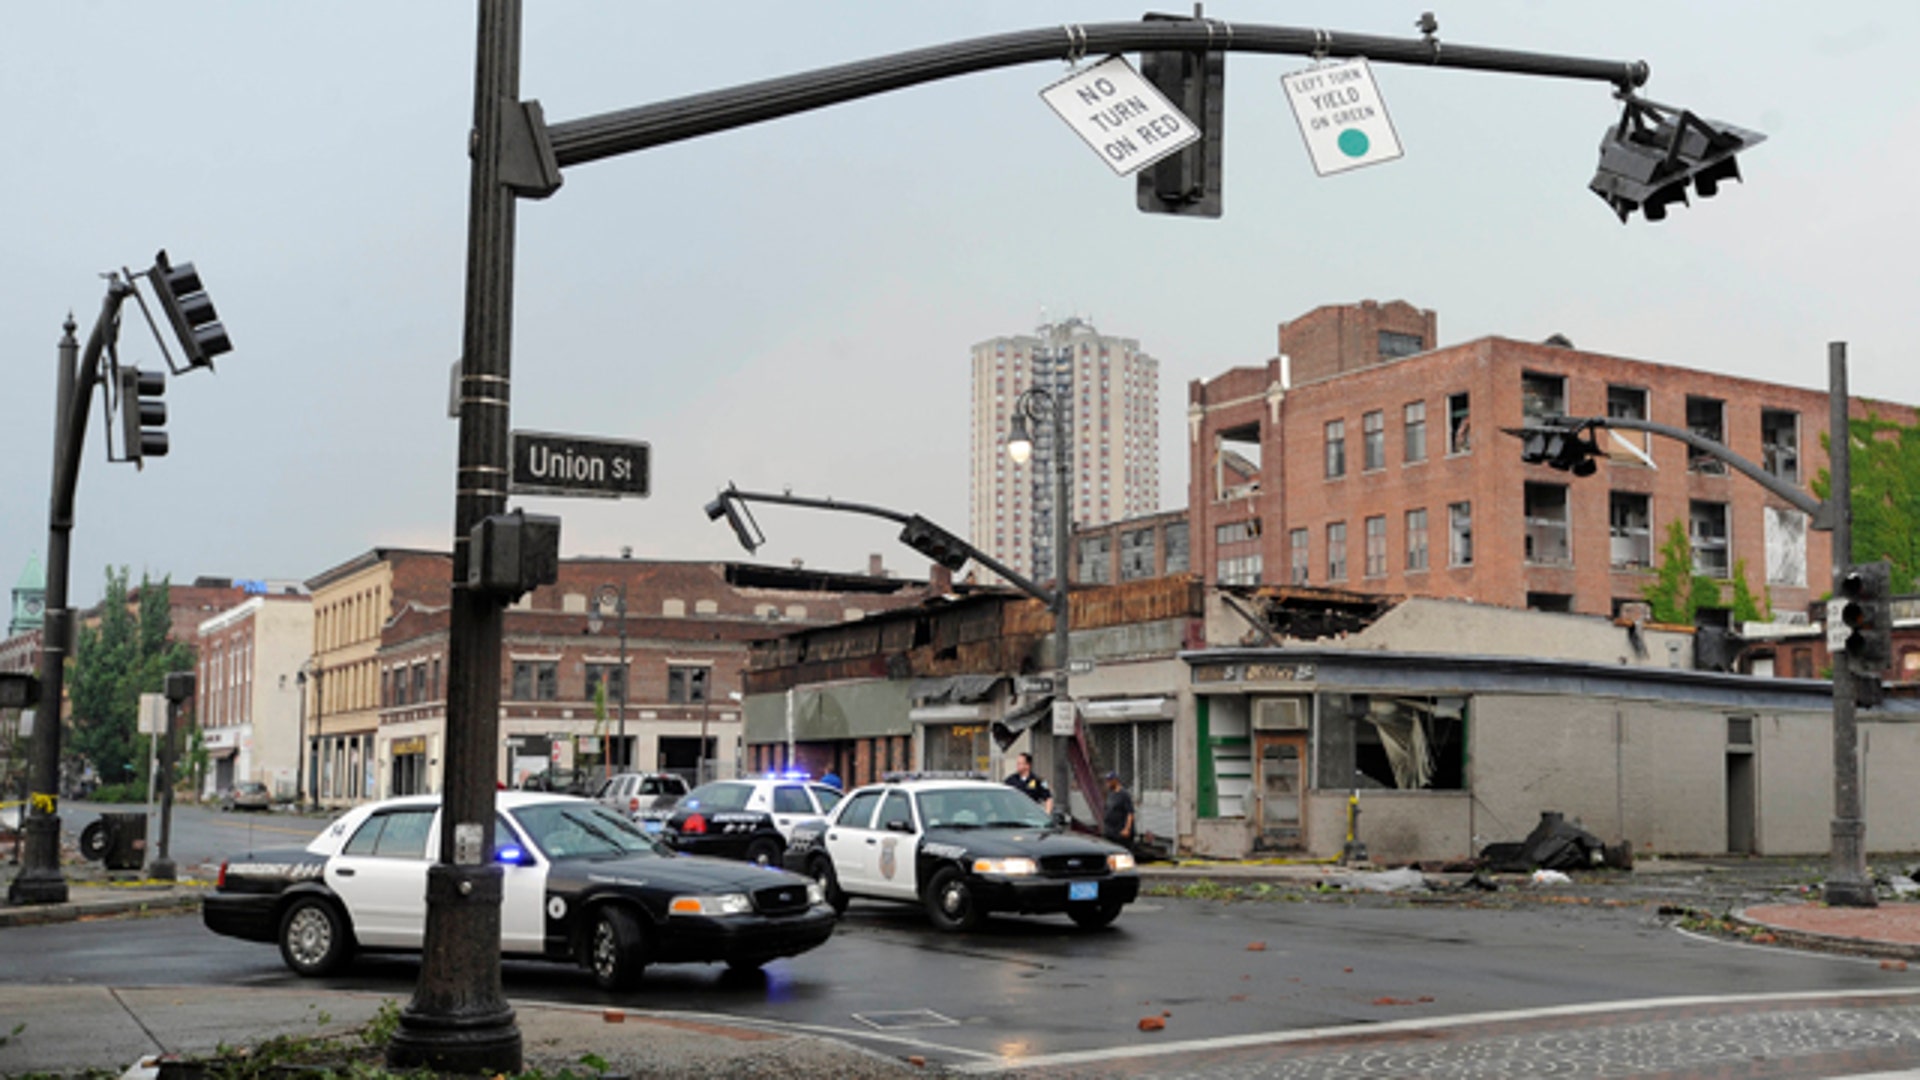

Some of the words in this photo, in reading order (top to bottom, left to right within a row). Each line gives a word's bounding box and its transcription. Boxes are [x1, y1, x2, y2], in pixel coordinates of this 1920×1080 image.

[1076, 77, 1116, 105] NO
[1293, 76, 1323, 93] LEFT
[1328, 68, 1361, 84] TURN
[1311, 87, 1360, 110] YIELD
[1089, 95, 1149, 132] TURN
[1310, 117, 1330, 129] ON
[1332, 106, 1375, 125] GREEN
[1104, 135, 1138, 161] ON
[1136, 114, 1180, 145] RED
[530, 445, 604, 481] Union
[611, 457, 631, 480] St
